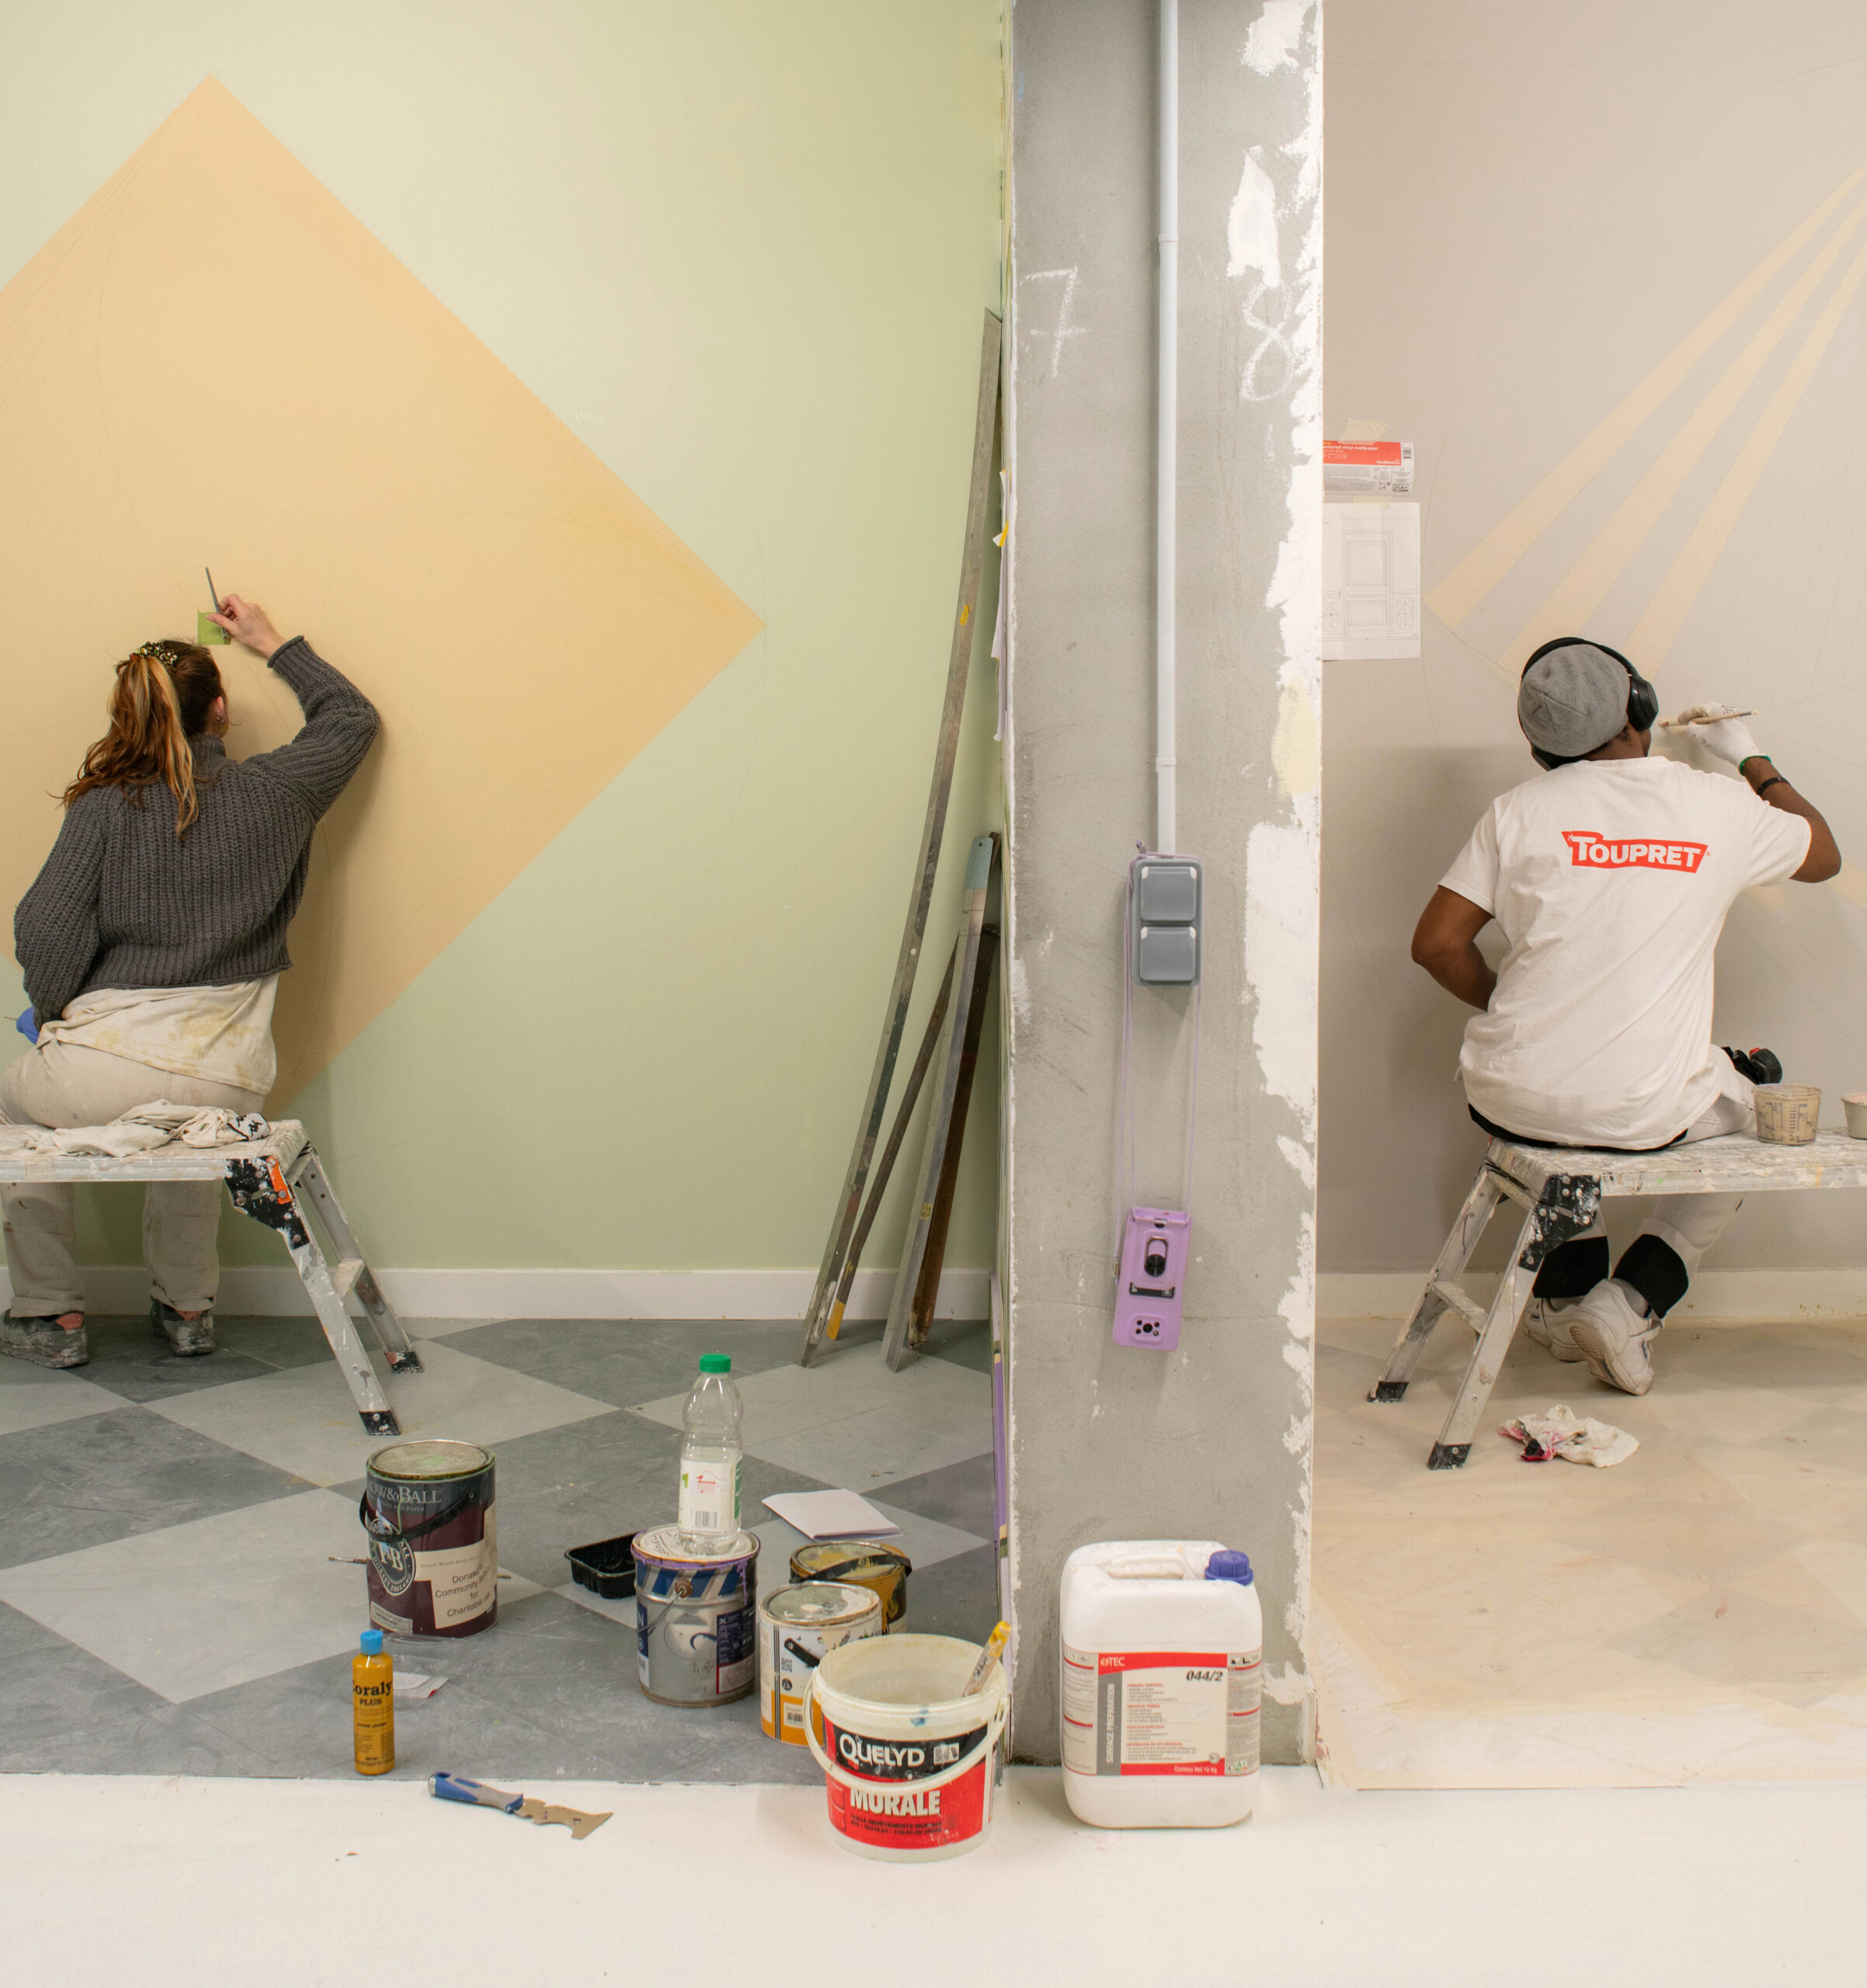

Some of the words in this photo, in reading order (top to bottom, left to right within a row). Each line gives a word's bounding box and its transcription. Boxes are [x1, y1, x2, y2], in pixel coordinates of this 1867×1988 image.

[1020, 266, 1089, 378] 7
[1241, 281, 1295, 401] 8
[1571, 836, 1701, 867] TOUPRET
[435, 1580, 478, 1598] Community
[447, 1599, 483, 1617] Charitable
[353, 1680, 391, 1696] oraly
[1187, 1670, 1223, 1681] 044/2
[839, 1733, 925, 1767] QUELYD
[850, 1787, 941, 1817] MURALE
